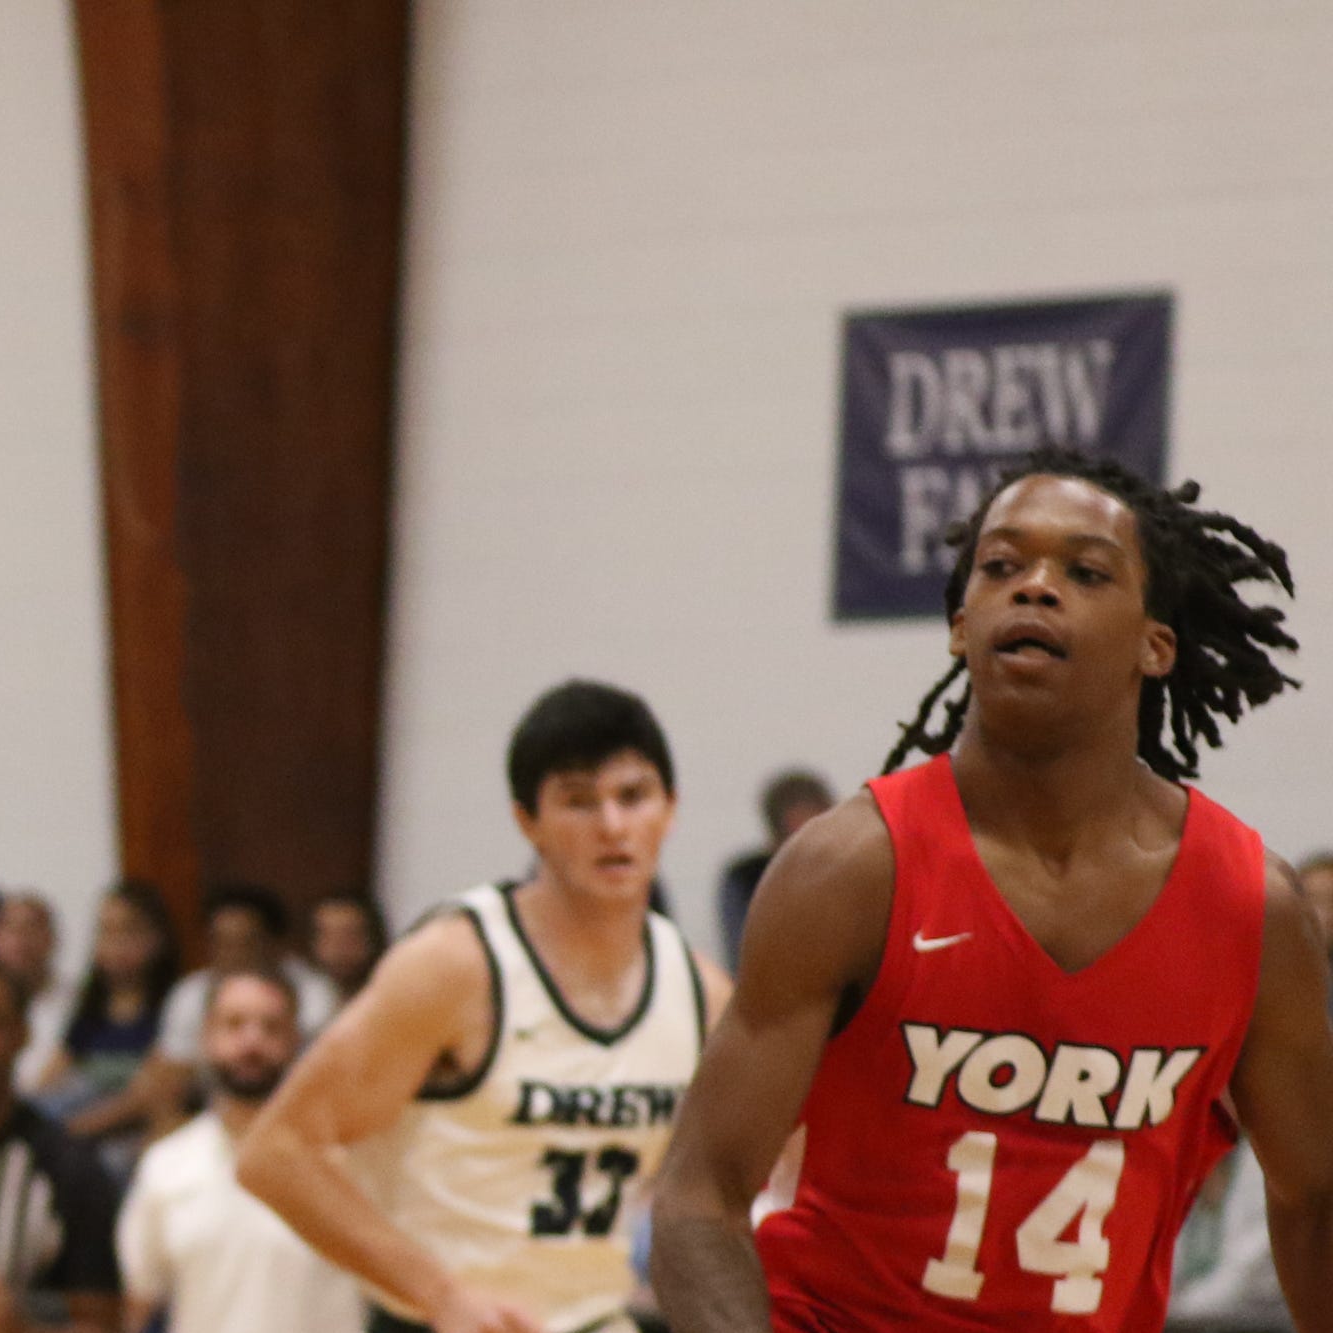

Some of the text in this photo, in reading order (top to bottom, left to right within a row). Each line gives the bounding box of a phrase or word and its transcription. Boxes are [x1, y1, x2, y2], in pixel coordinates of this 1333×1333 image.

[884, 339, 1115, 460] DREW
[507, 1081, 678, 1128] DREW
[900, 1022, 1209, 1131] YORK
[921, 1130, 1126, 1316] 14
